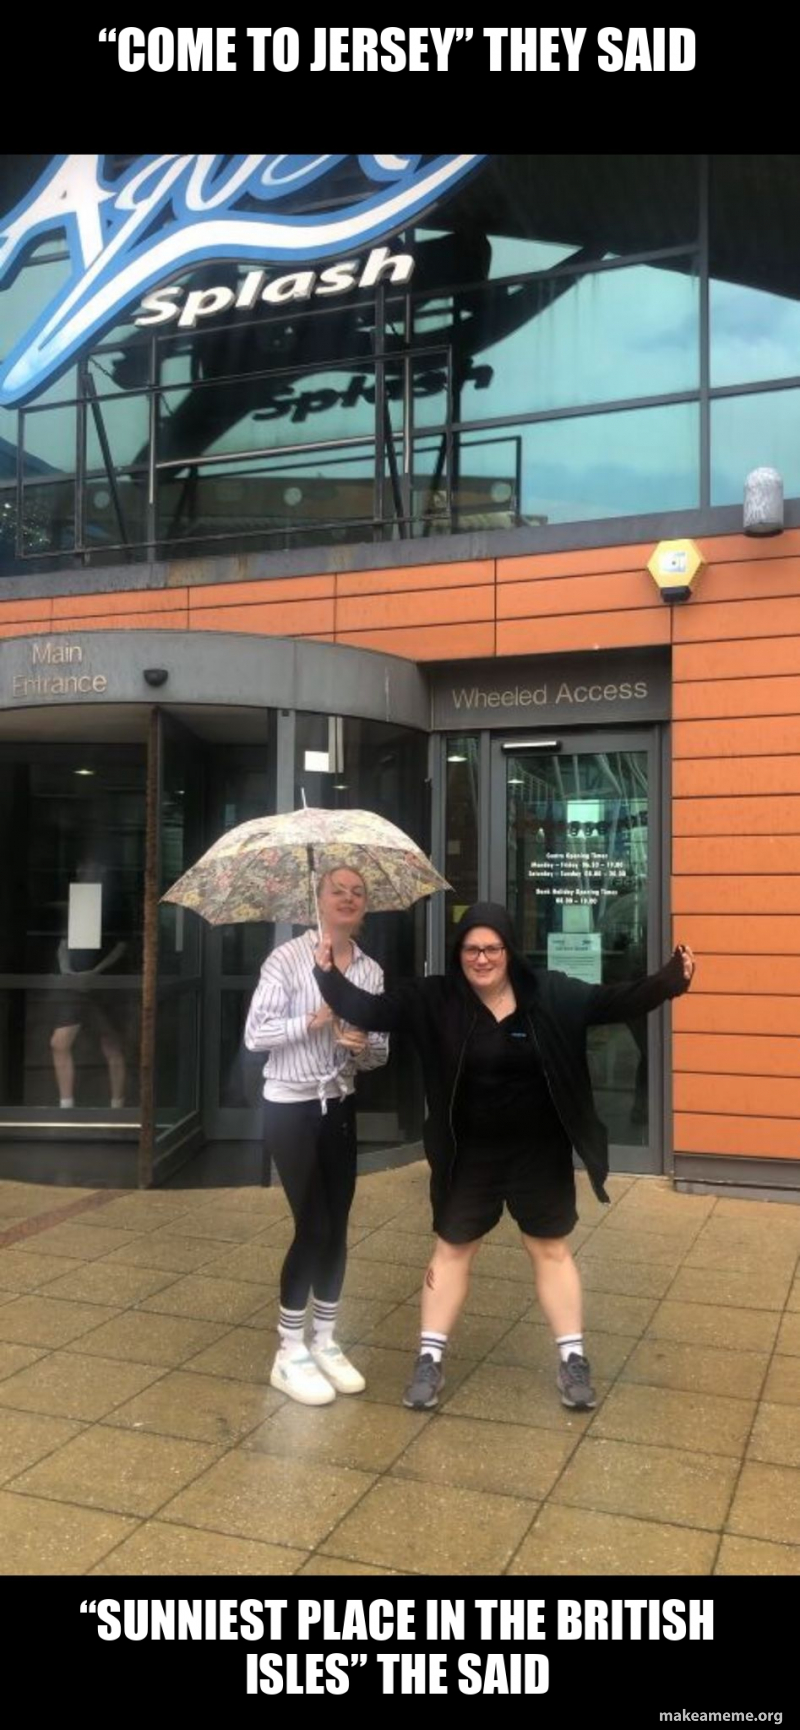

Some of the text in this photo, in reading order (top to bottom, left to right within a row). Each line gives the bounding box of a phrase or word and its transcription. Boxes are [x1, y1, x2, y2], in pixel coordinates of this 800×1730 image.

[134, 246, 416, 328] Splash
[32, 642, 83, 665] Main
[12, 674, 108, 698] Entrance
[452, 681, 648, 709] Wheeled Access
